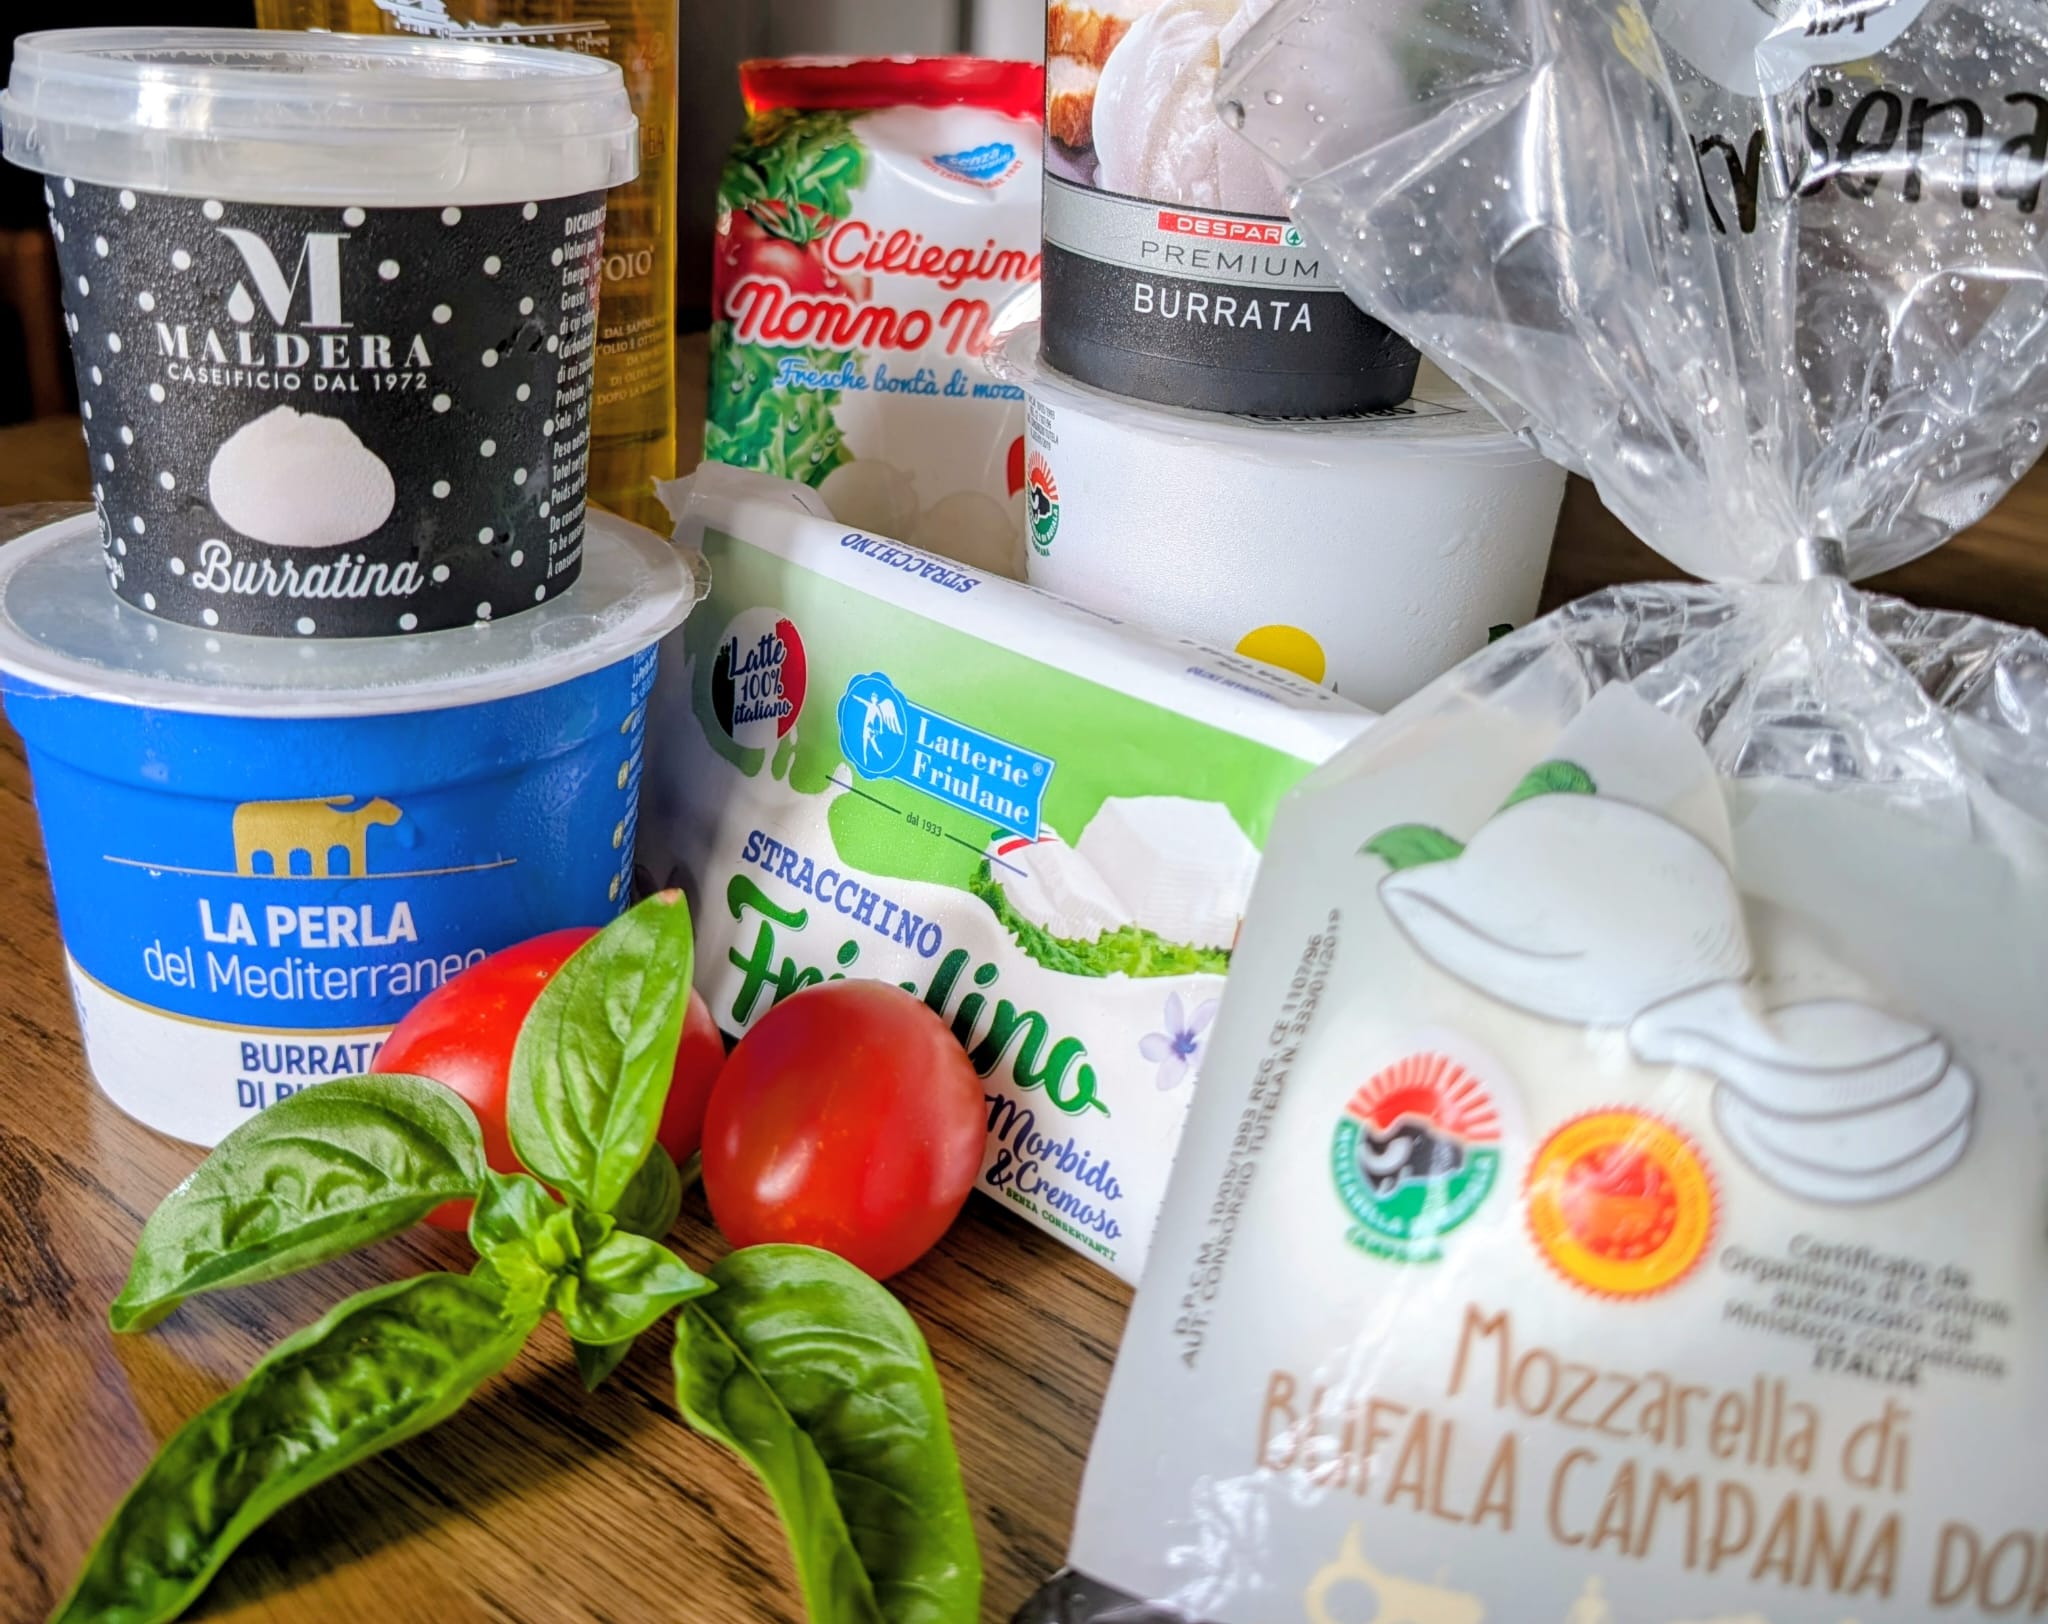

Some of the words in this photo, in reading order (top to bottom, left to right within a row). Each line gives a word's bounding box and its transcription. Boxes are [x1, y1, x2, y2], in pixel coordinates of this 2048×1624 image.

[1177, 217, 1281, 242] DESPAR
[1141, 240, 1319, 279] PREMIUM
[731, 281, 932, 350] Nonno
[1134, 282, 1312, 332] BURRATA
[155, 322, 432, 370] MALDERA
[167, 362, 300, 391] CASEIFICIO
[314, 374, 359, 392] DAL
[373, 372, 427, 392] 1972
[774, 359, 868, 390] Fresche
[873, 365, 937, 397] bontà
[943, 368, 968, 398] di
[192, 539, 424, 598] Burratina
[840, 533, 982, 593] STRACCHINO
[729, 631, 786, 678] Latte
[741, 667, 783, 702] 100%
[734, 699, 792, 725] italiano
[912, 749, 1030, 825] Friulane
[906, 812, 919, 826] dal
[922, 818, 943, 837] 1933
[742, 830, 942, 958] STRACCHINO
[199, 897, 258, 947] LA
[265, 900, 418, 949] PERLA
[144, 938, 195, 989] del
[237, 1079, 265, 1109] DI
[985, 1093, 1123, 1200] Morbido
[1447, 1301, 1819, 1476] Mozzarella
[1840, 1393, 1911, 1495] di
[1546, 1446, 1904, 1602] CAMPANA
